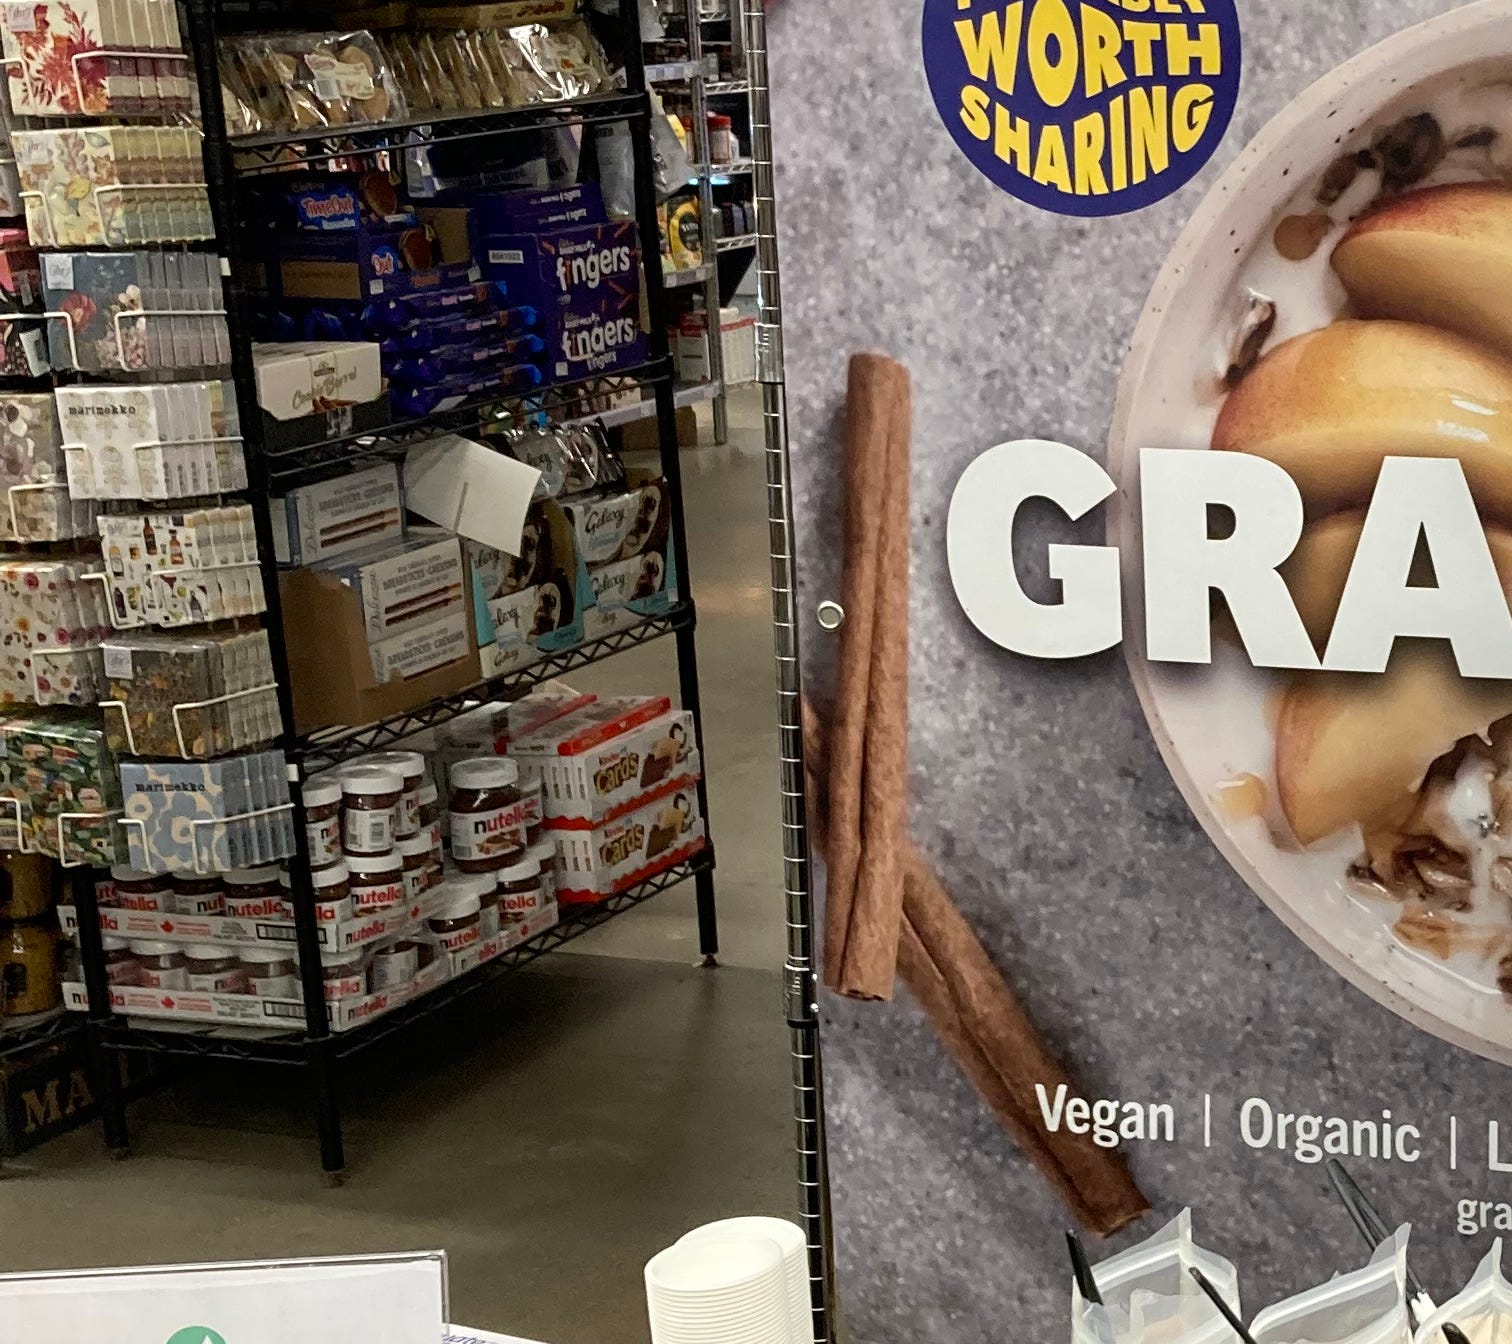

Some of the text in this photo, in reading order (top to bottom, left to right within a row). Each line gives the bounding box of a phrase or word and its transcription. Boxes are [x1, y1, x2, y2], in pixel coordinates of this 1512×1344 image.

[959, 83, 1215, 195] SHARING
[556, 246, 630, 292] fingers
[68, 406, 136, 416] marimekko
[585, 506, 626, 534] Galaxy
[135, 782, 206, 792] marimekko
[594, 753, 640, 794] Cards
[600, 824, 645, 865] Cards
[351, 887, 401, 908] nutella
[345, 921, 386, 945] nutella
[348, 997, 388, 1022] nutella
[1035, 1083, 1175, 1148] Vegan
[1240, 1097, 1421, 1163] Organic
